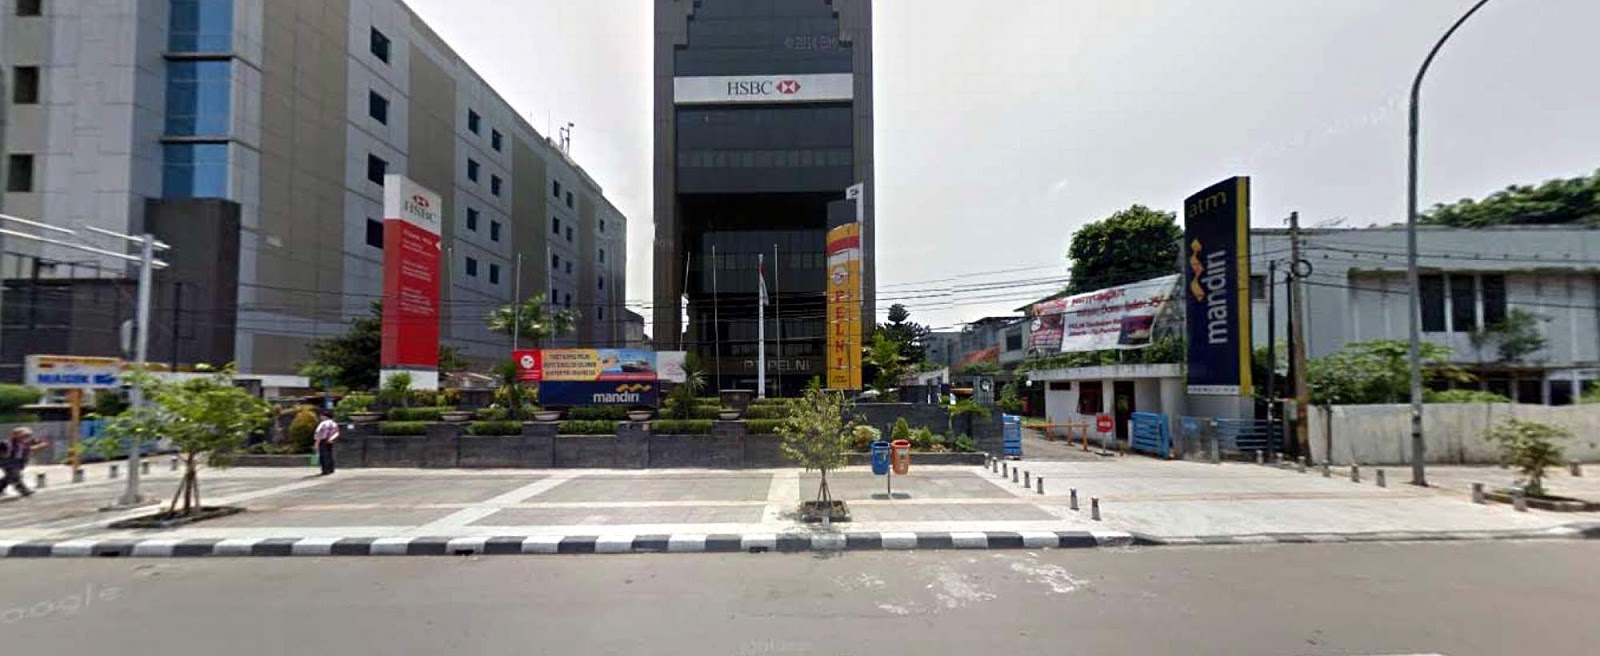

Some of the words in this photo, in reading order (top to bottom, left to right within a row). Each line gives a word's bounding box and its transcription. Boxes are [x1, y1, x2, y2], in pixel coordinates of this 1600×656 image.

[727, 81, 773, 95] HSBC
[404, 200, 437, 223] HSBC
[1188, 191, 1227, 219] atm
[1202, 250, 1228, 344] mandiri
[834, 290, 845, 370] PELNI
[767, 359, 810, 371] PELNI
[593, 391, 639, 403] mandiri
